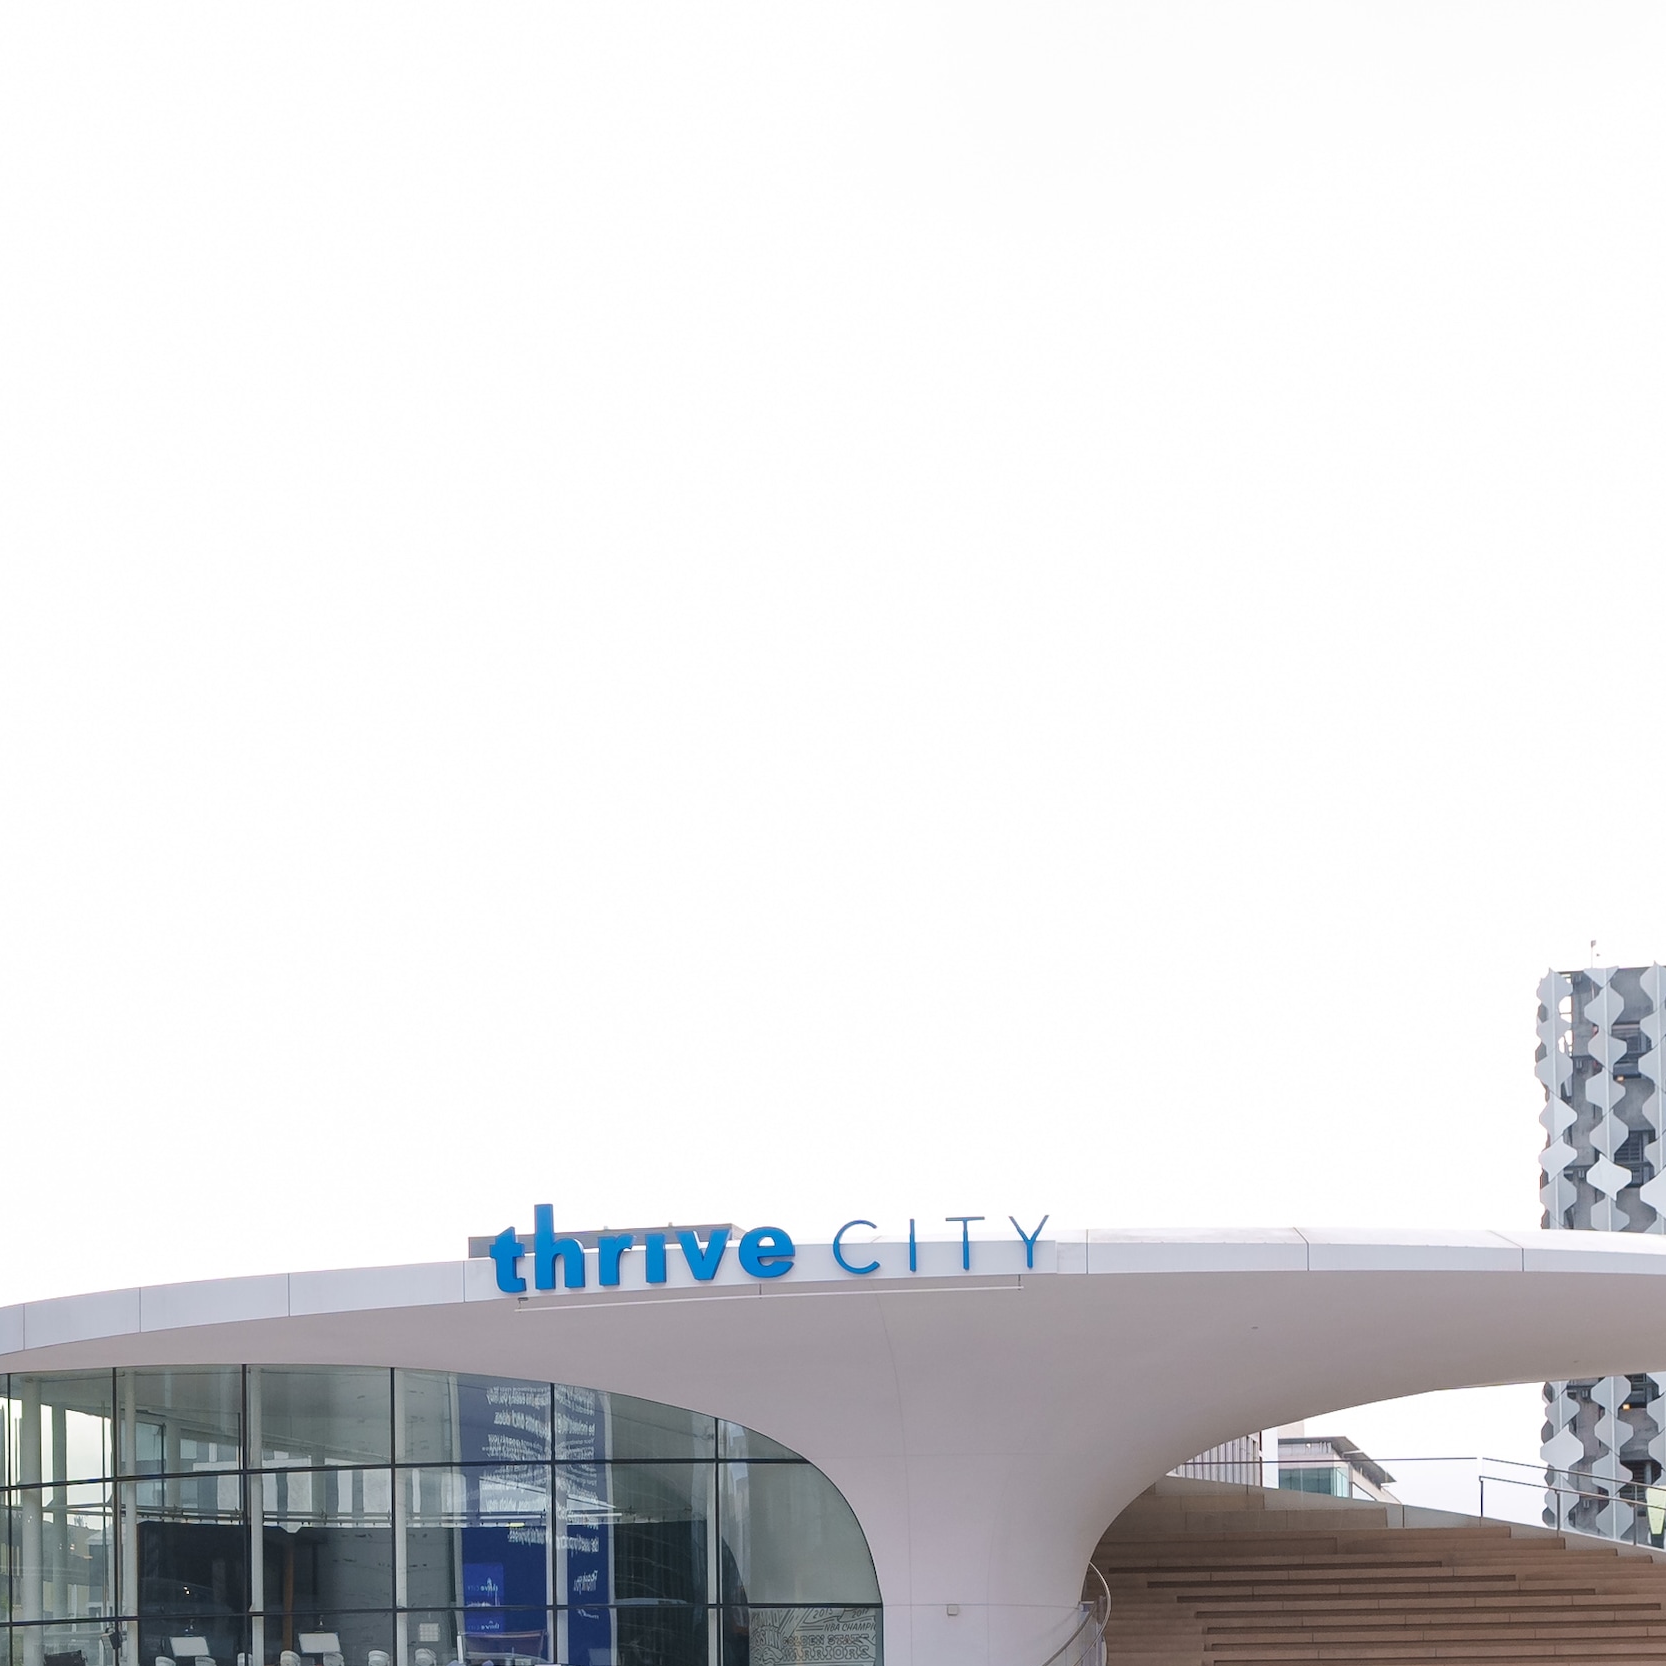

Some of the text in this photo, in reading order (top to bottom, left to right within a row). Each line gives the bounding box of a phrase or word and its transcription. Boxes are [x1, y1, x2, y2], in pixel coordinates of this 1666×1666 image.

[490, 1203, 1050, 1293] thrive CITY
[823, 1623, 840, 1632] NBA
[783, 1646, 870, 1661] WARRIORS
